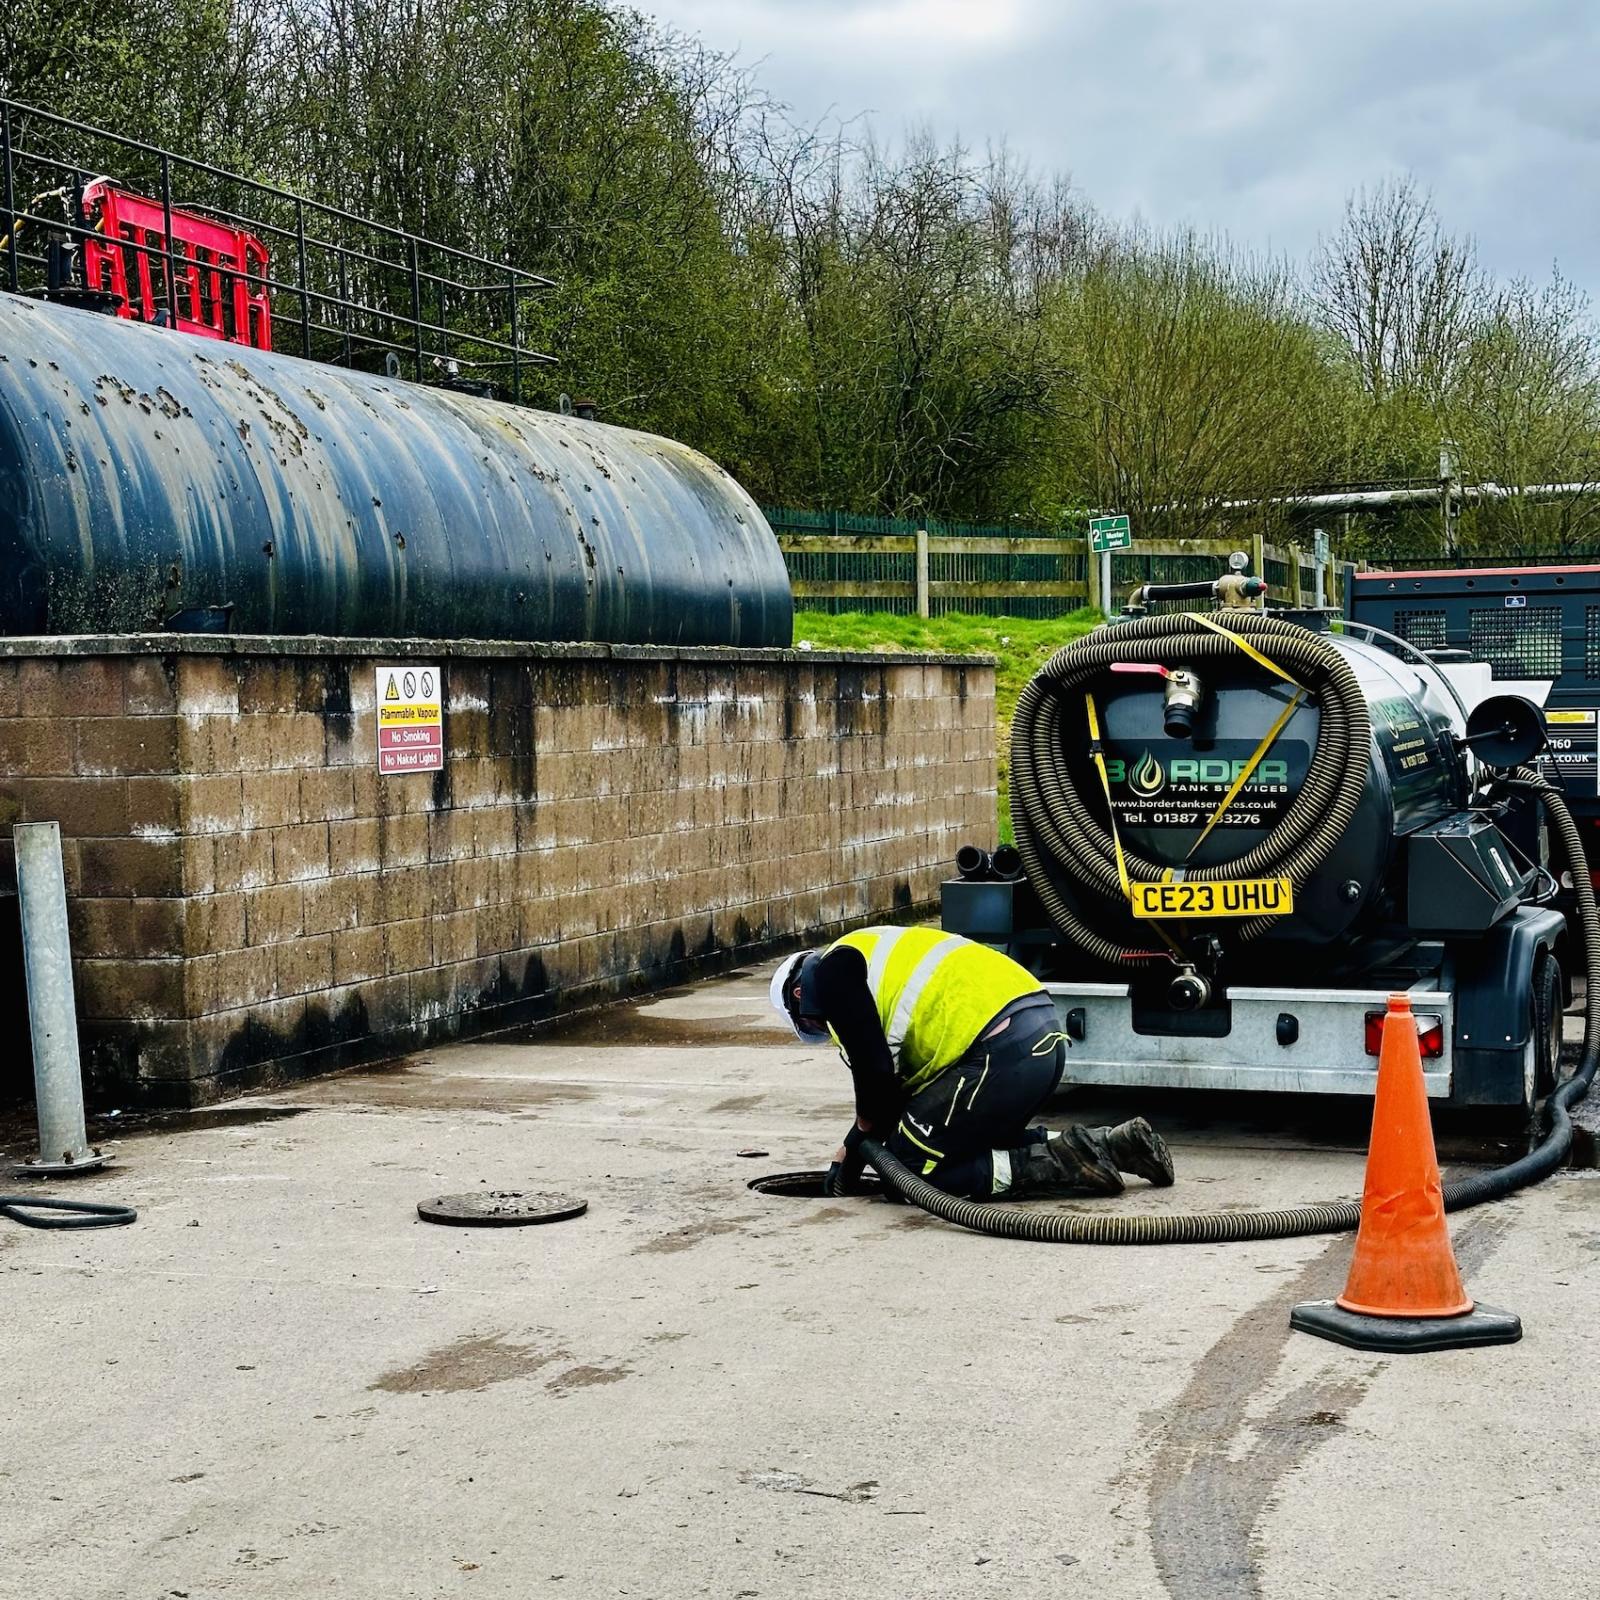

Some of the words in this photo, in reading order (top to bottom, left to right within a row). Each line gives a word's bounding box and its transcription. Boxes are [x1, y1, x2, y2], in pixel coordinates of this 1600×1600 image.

[1093, 529, 1100, 542] 2
[380, 708, 415, 720] Flammable
[417, 707, 439, 719] Vapour
[391, 731, 401, 743] No
[403, 730, 431, 743] Smoking
[1542, 738, 1571, 749] 160
[384, 754, 395, 766] No
[396, 753, 417, 765] Naked
[418, 752, 438, 765] Lights
[1539, 754, 1590, 763] E.CO.UK
[1169, 784, 1209, 792] TANK
[1213, 785, 1288, 793] SEVICES
[1109, 799, 1277, 809] www.bordertankserces.co.uk
[1122, 812, 1147, 823] Tel.
[1153, 813, 1199, 824] 01387
[1143, 885, 1215, 913] CE23
[1222, 882, 1279, 911] UHU
